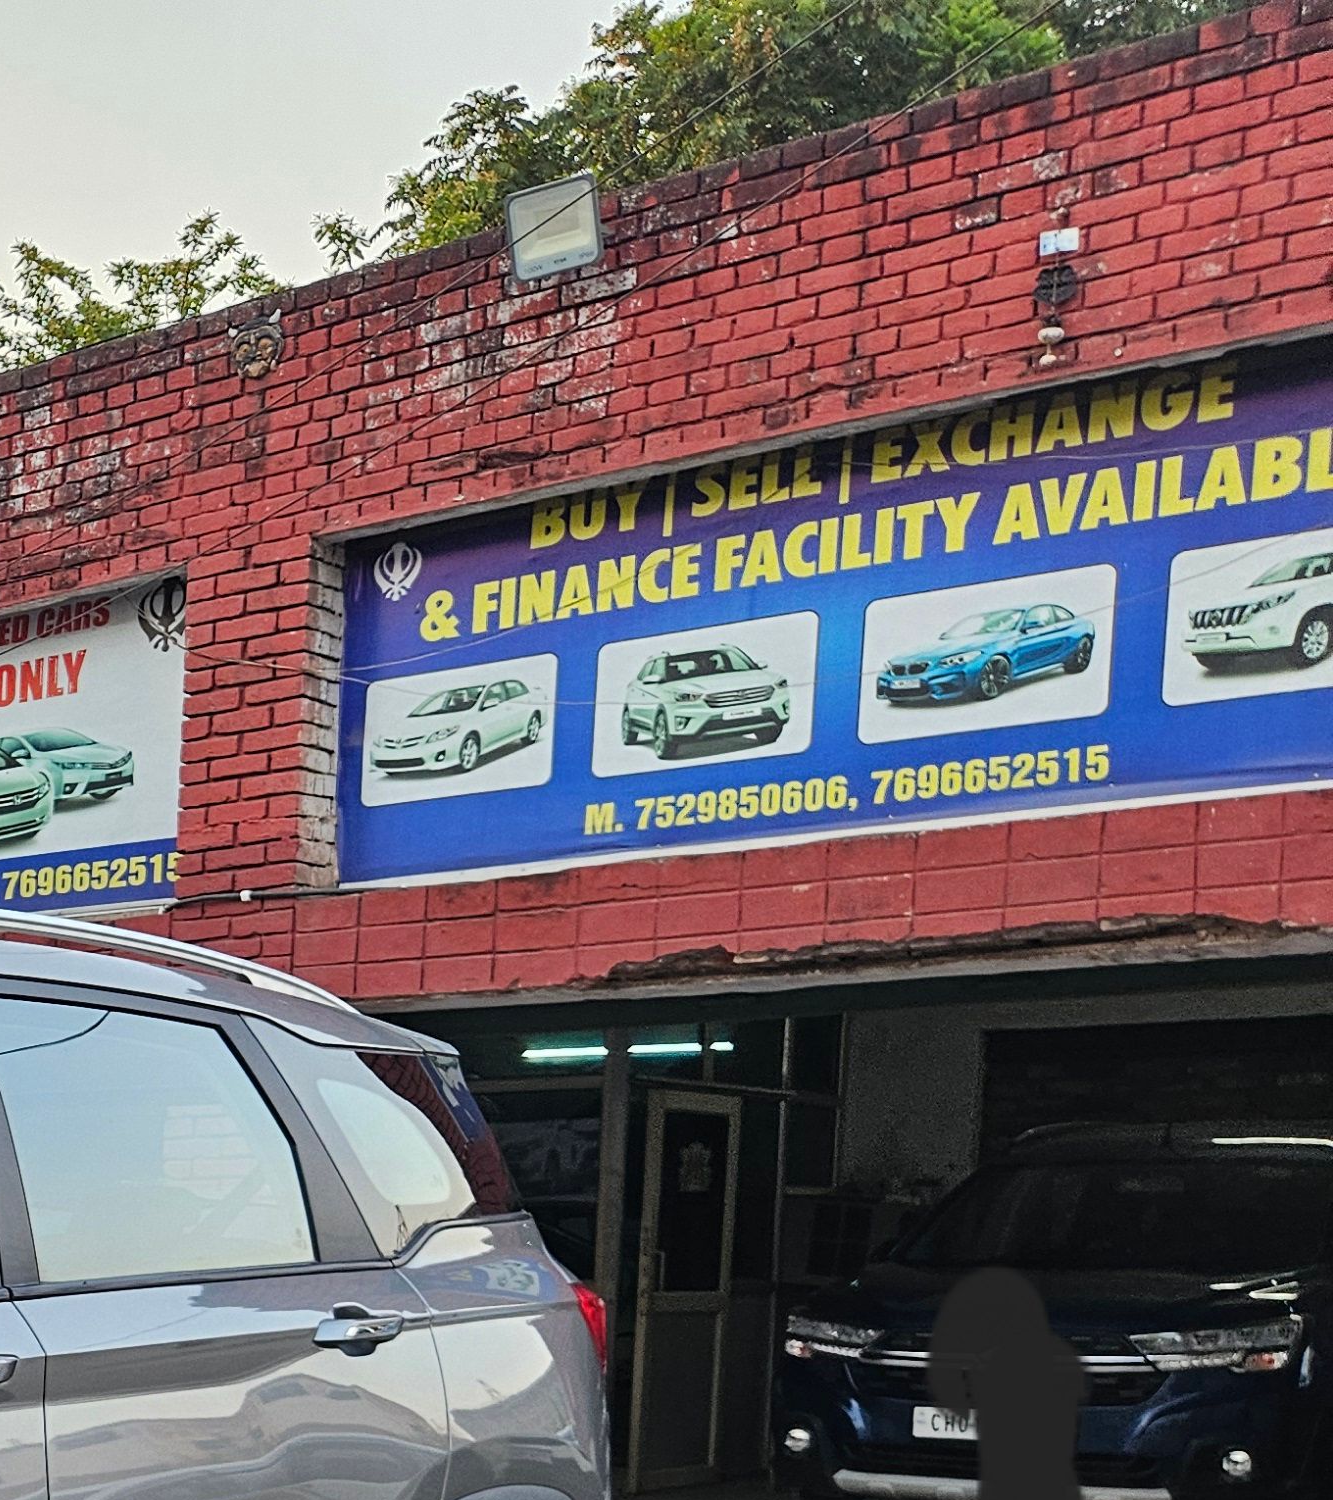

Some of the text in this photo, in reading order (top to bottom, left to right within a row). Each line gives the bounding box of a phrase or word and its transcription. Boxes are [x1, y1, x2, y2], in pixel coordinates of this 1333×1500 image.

[530, 480, 643, 549] BUY
[691, 443, 822, 517] SELL
[871, 361, 1234, 484] EXCHANGE
[36, 596, 111, 639] CARS
[419, 590, 461, 642] &
[471, 544, 702, 635] FINANCE
[713, 490, 981, 592] FACILITY
[584, 744, 1110, 835] M. 7529850606, 7696652515
